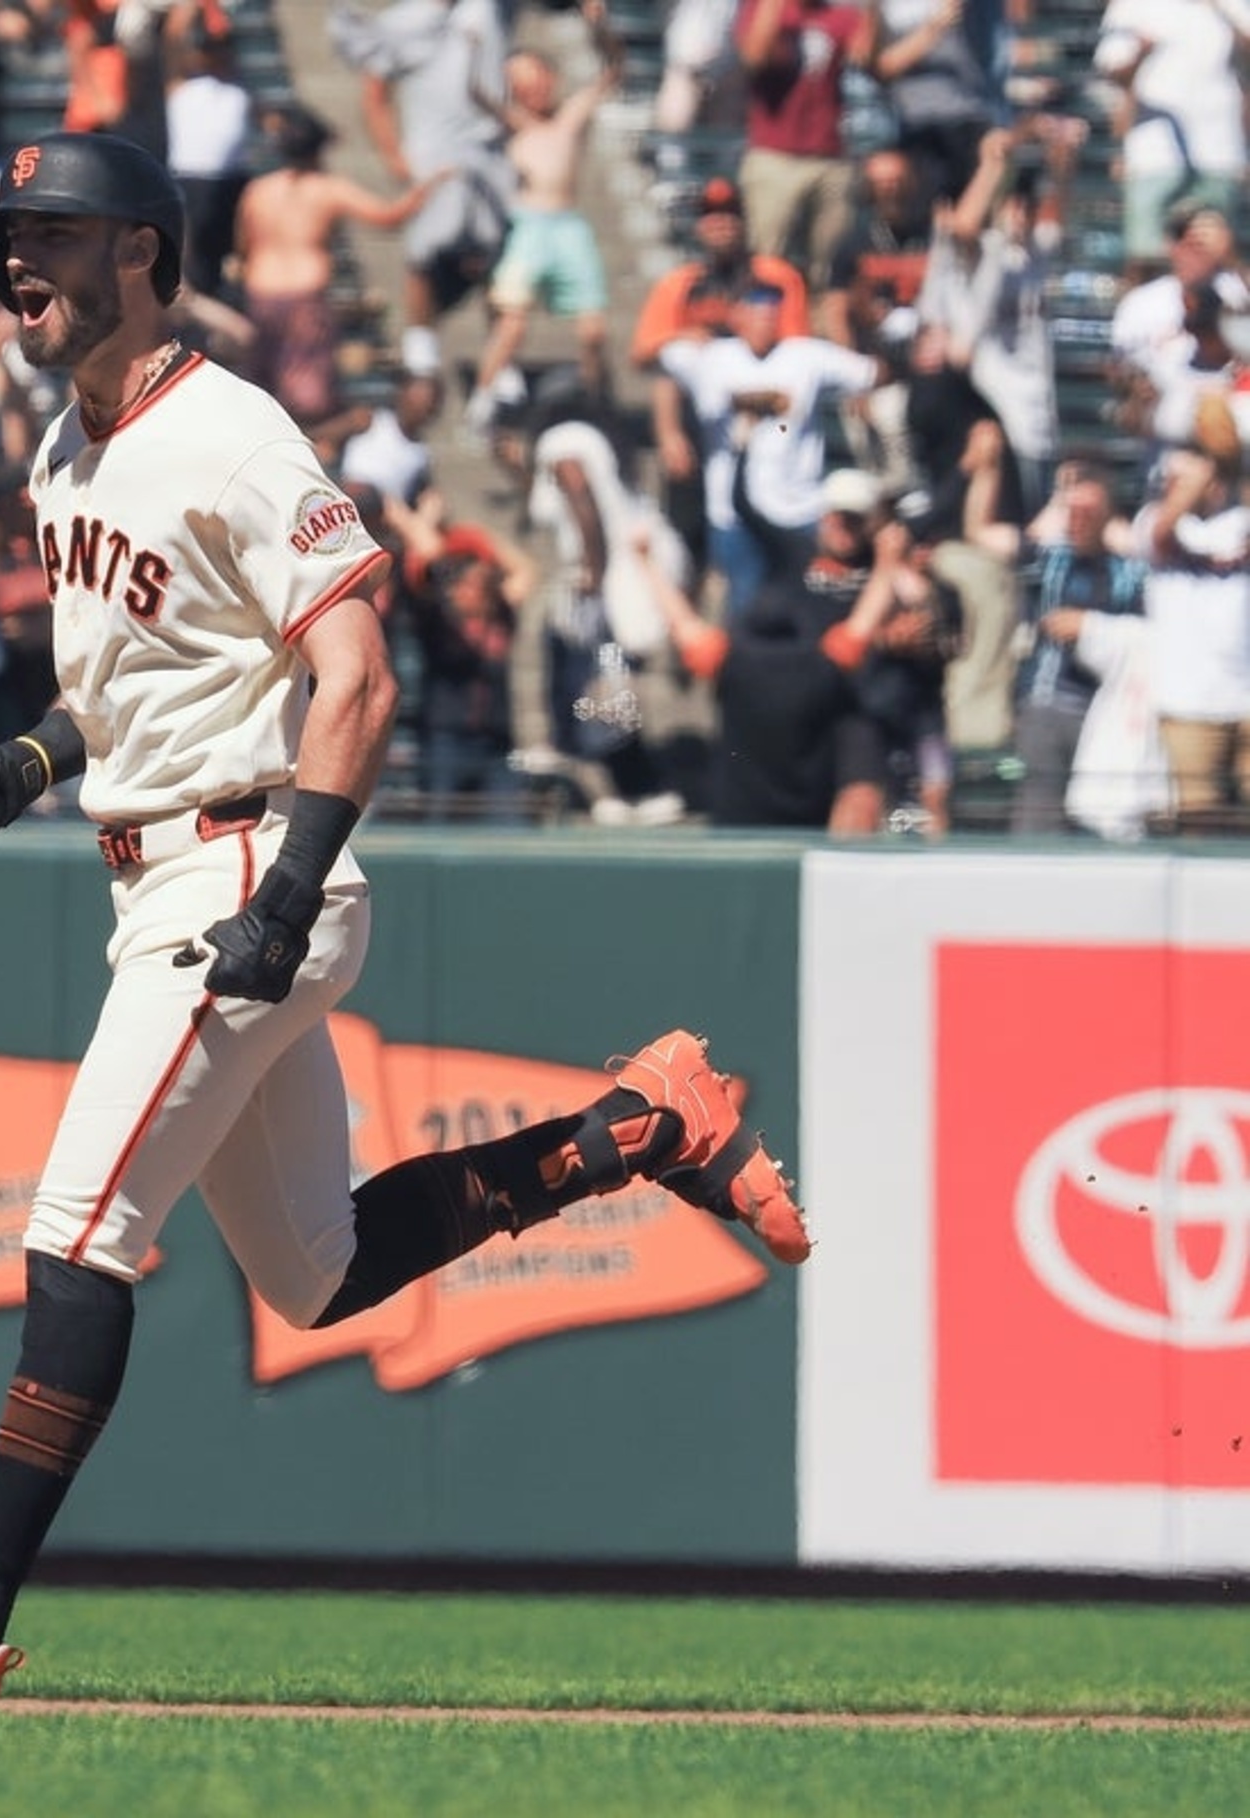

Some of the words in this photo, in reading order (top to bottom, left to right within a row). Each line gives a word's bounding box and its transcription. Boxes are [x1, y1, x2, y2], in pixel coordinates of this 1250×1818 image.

[12, 146, 40, 187] SF
[288, 500, 358, 554] GIANTS
[42, 514, 173, 624] ANTS
